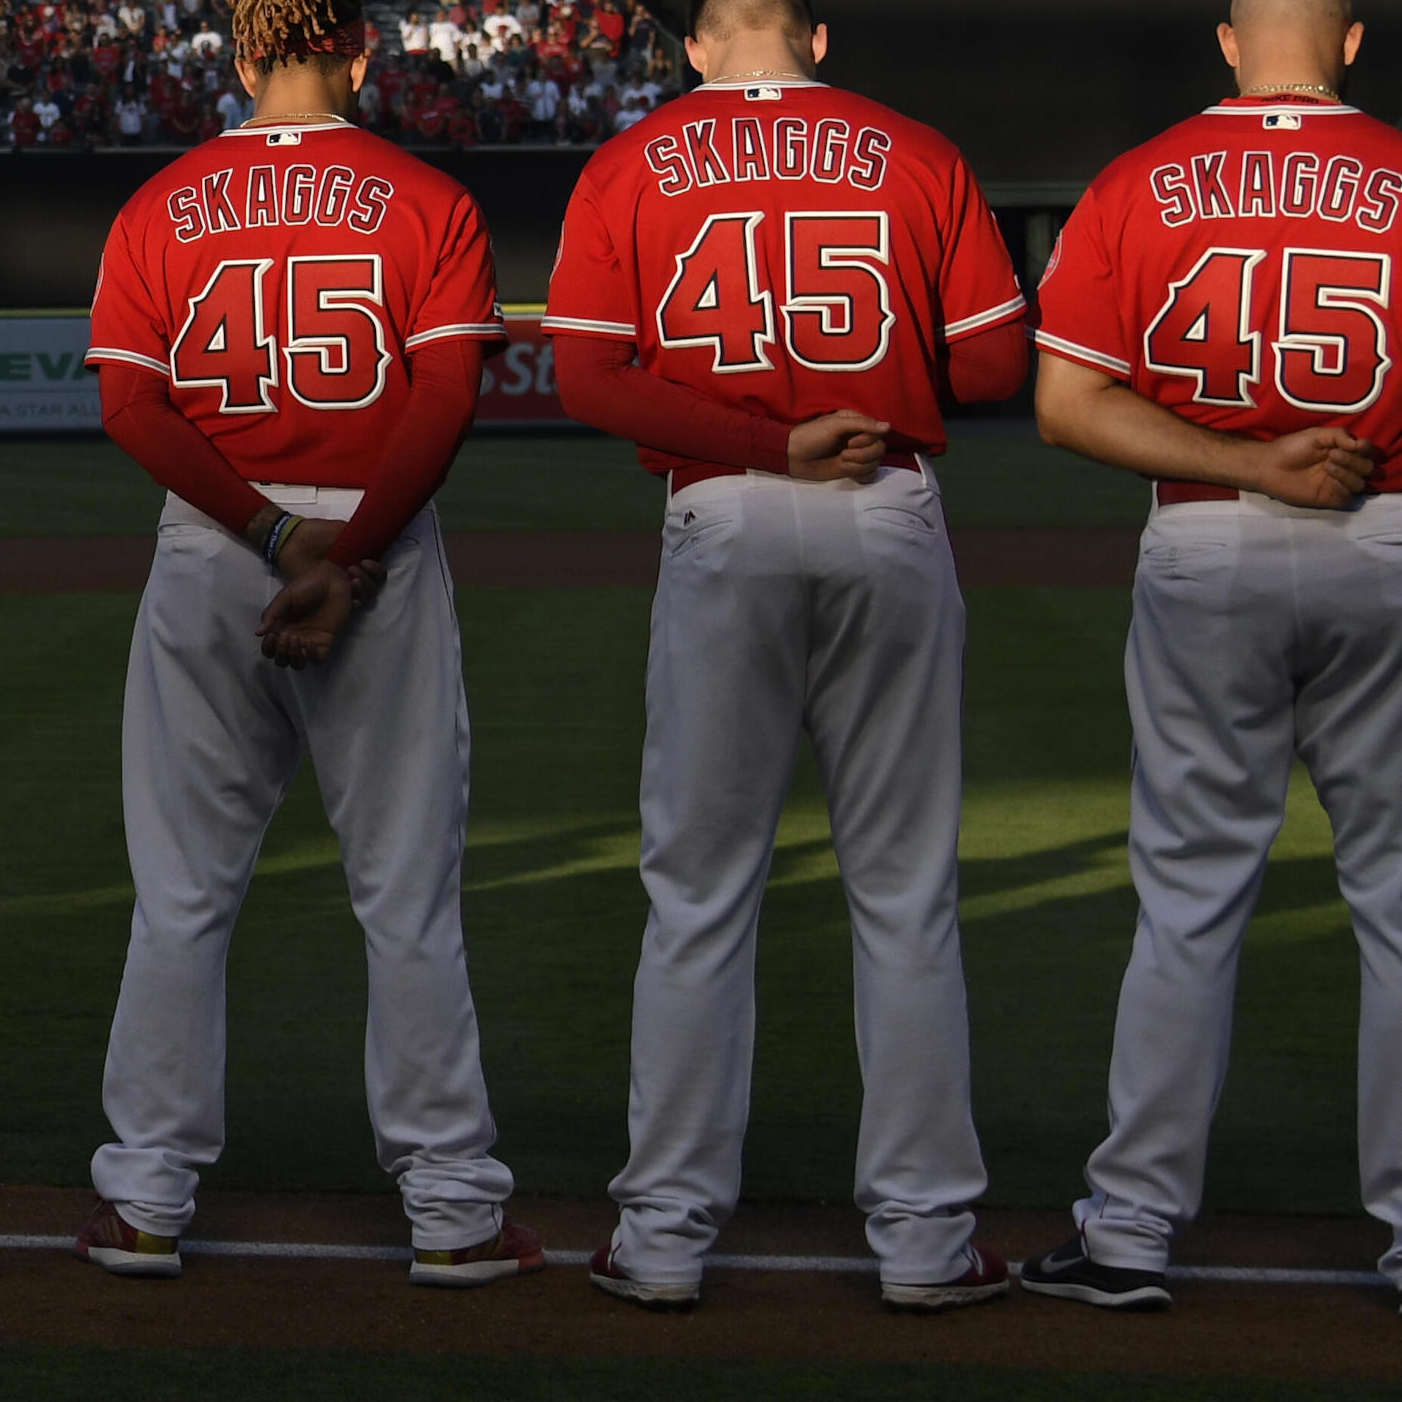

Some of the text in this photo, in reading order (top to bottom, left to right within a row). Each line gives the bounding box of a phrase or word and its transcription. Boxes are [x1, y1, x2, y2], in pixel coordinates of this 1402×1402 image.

[166, 164, 394, 244] SKAGGS
[643, 118, 891, 197] SKAGGS
[1150, 151, 1402, 233] SKAGGS
[171, 254, 393, 414] 45
[656, 210, 897, 375] 45
[1143, 247, 1392, 414] 45
